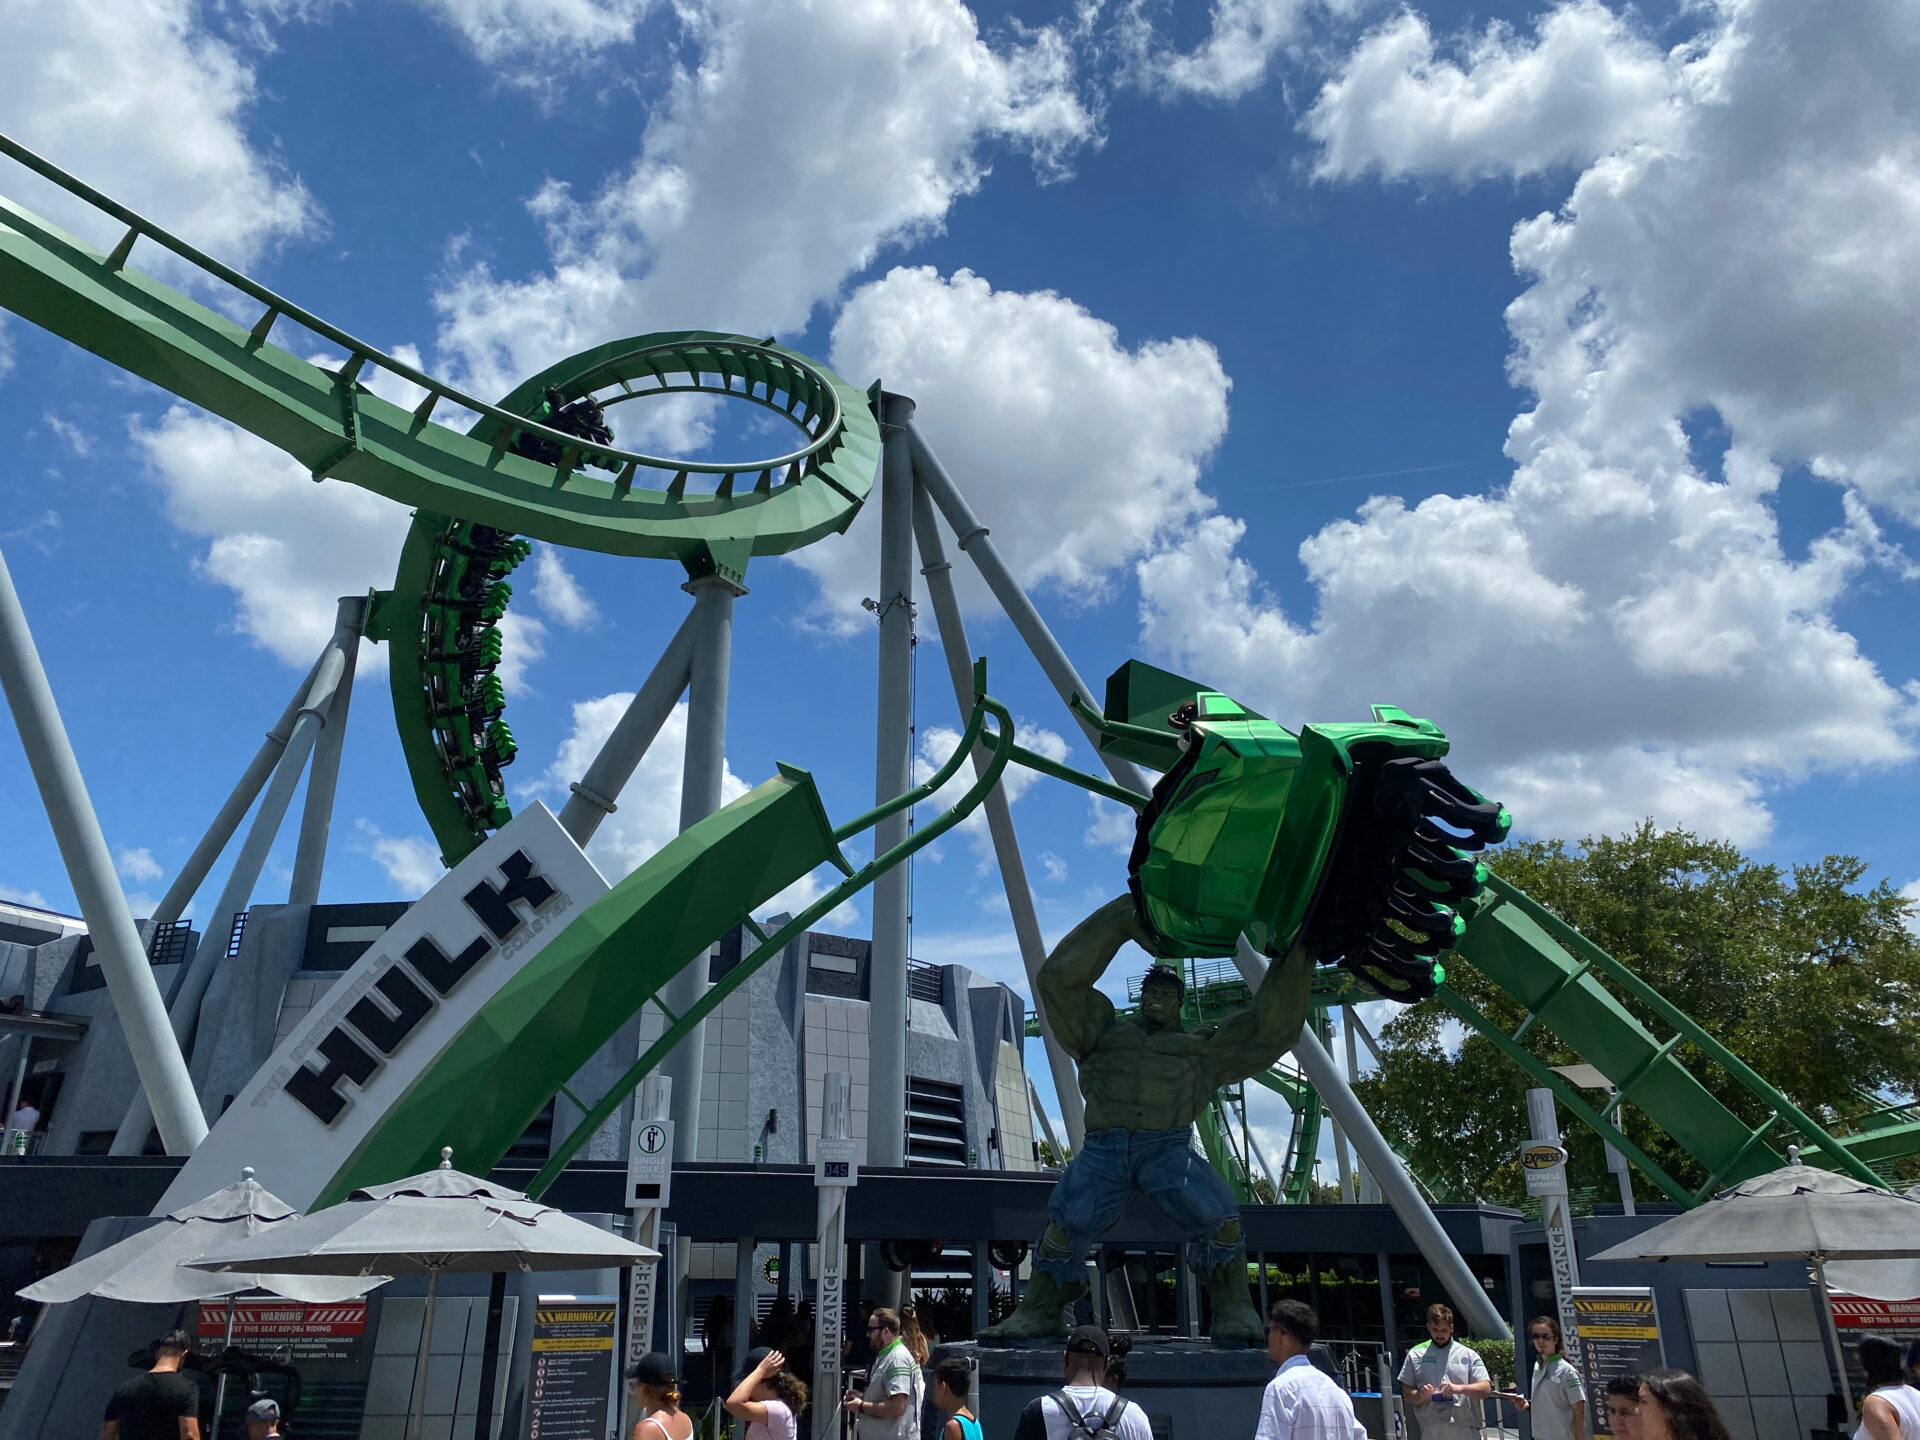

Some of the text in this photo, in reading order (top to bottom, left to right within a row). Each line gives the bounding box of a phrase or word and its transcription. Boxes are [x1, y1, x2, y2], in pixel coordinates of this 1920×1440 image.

[501, 893, 574, 961] COASTER
[283, 847, 562, 1130] HULK
[633, 1157, 666, 1165] SINGLE
[1524, 1152, 1560, 1167] EXPRESS
[632, 1165, 665, 1174] RIDERS
[825, 1163, 848, 1176] 045
[1527, 1173, 1560, 1182] EXPRESS
[633, 1265, 651, 1317] RIDER
[1550, 1226, 1584, 1367] RESS ENTRANCE
[1591, 1302, 1635, 1312] WARNING!
[555, 1311, 598, 1322] WARNING!
[822, 1267, 838, 1371] ENTRANCE
[231, 1325, 332, 1333] EST THIS SEAT BEFORE RIDING
